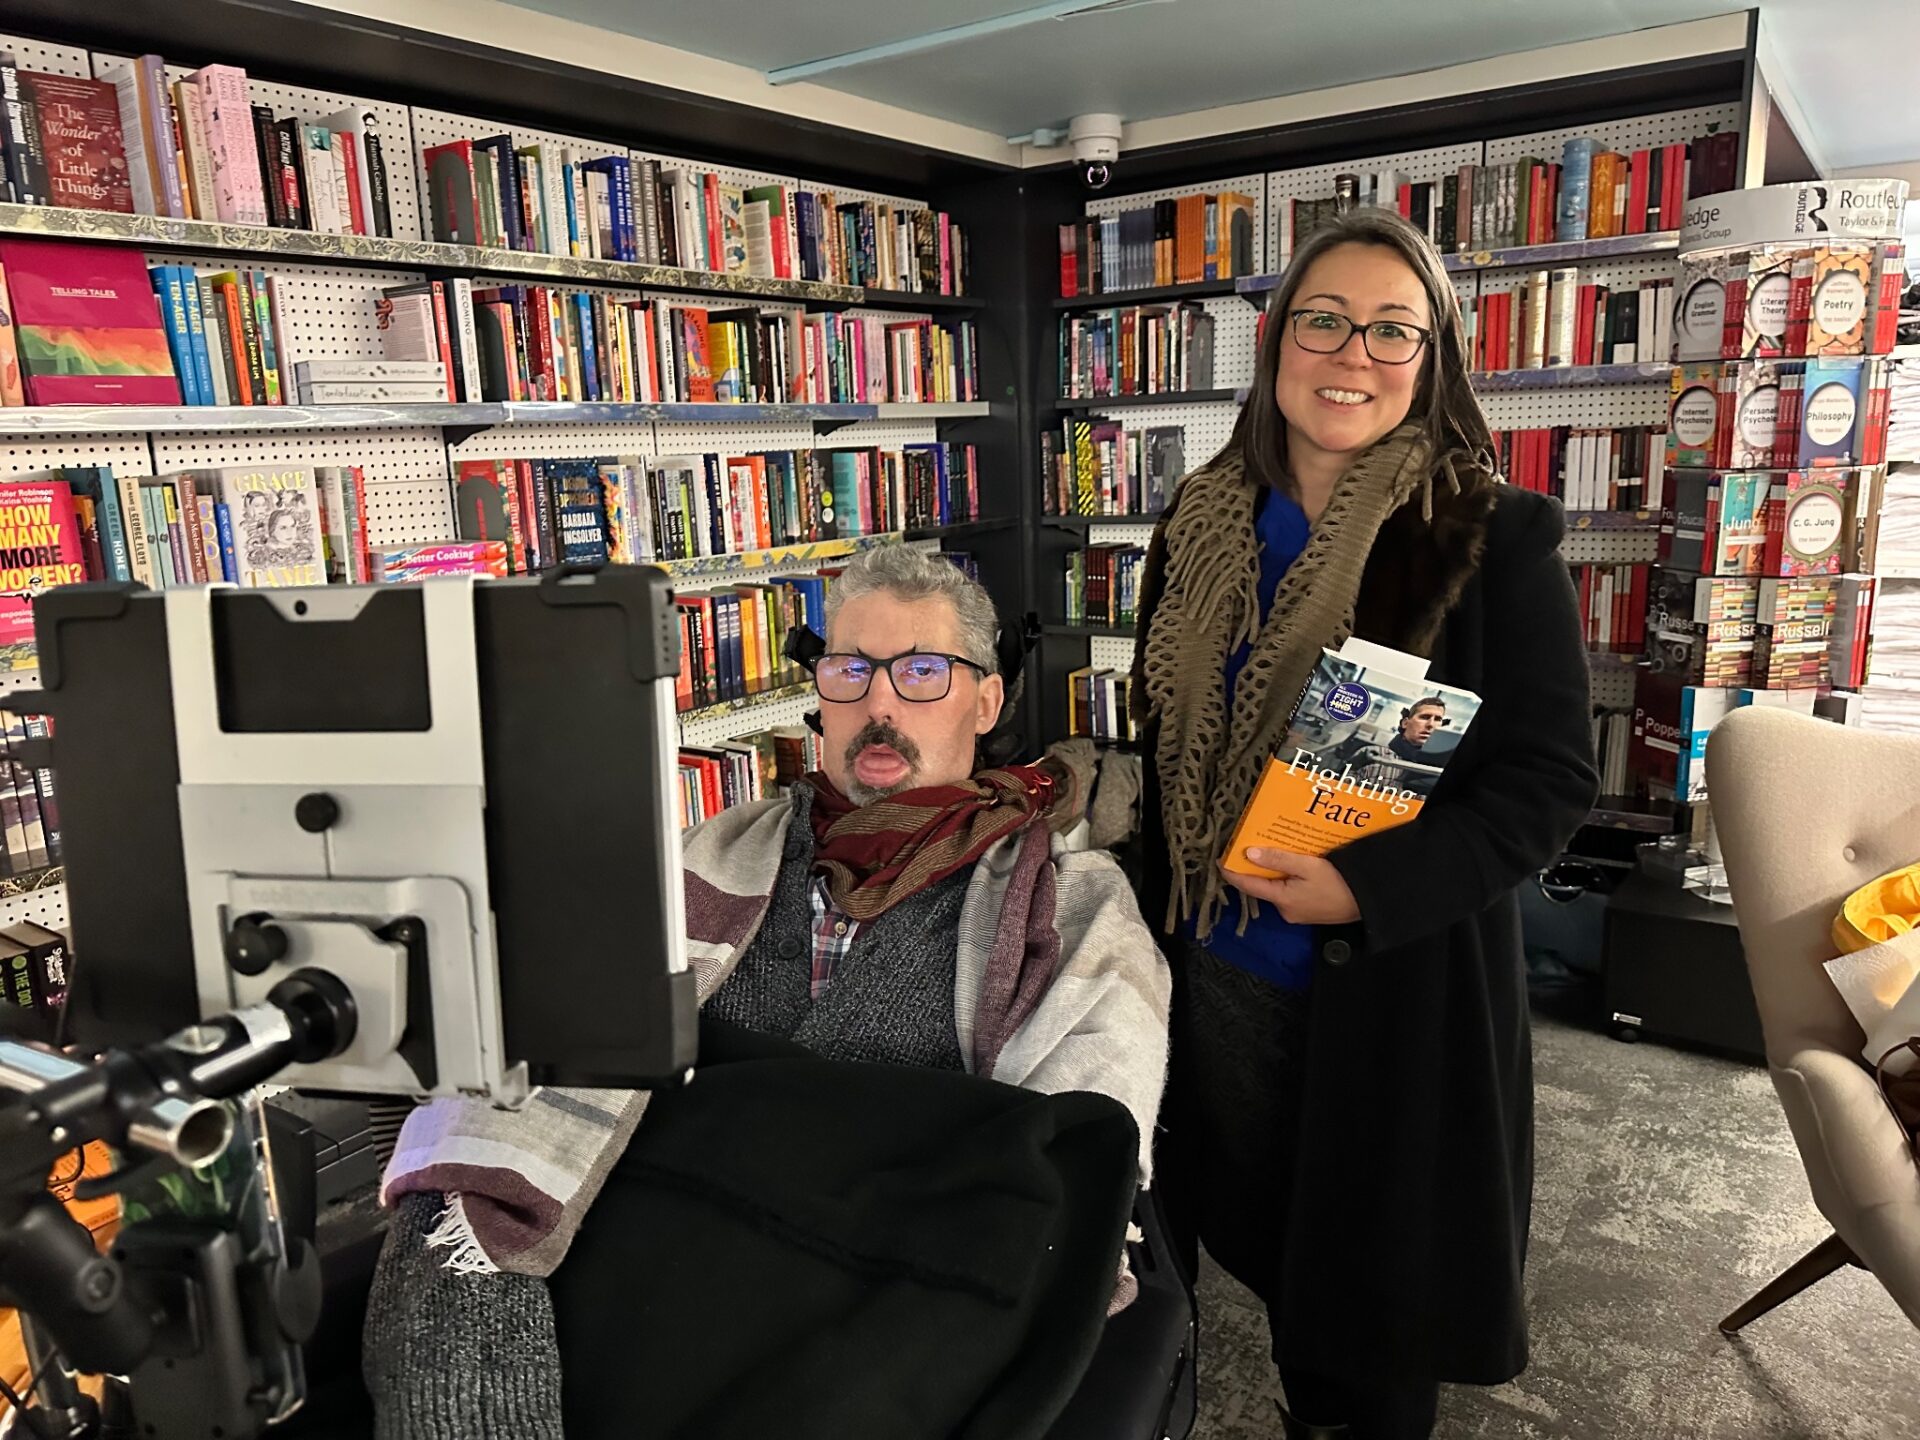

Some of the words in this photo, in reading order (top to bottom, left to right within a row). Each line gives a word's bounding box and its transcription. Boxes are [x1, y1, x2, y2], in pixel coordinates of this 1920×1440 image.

[1, 66, 19, 99] Stalking
[52, 103, 85, 120] The
[7, 102, 27, 144] Claremont
[45, 120, 101, 140] Wonder
[67, 142, 85, 157] of
[280, 131, 291, 151] CATCH
[369, 138, 379, 170] Hannah
[58, 160, 98, 177] Little
[283, 164, 296, 179] KILL
[52, 177, 110, 200] Things
[373, 171, 384, 202] Gadsby
[1840, 216, 1868, 227] Taylor
[1871, 217, 1877, 226] &
[636, 225, 645, 258] BARDUGO
[648, 227, 658, 259] BARDUGO
[1703, 228, 1731, 239] Group
[50, 287, 88, 296] TELLING
[89, 289, 116, 297] TALES
[202, 286, 214, 315] PRICK
[169, 280, 187, 334] TEN-AGER
[185, 281, 202, 335] TEN-AGER
[459, 282, 473, 336] BECOMING
[1694, 301, 1715, 310] English
[1762, 306, 1786, 314] Theory
[1823, 300, 1853, 310] Poetry
[1676, 416, 1713, 424] Psychology
[1806, 411, 1852, 421] Philosophy
[233, 471, 308, 492] GRACE
[505, 467, 514, 494] BEASTS
[536, 466, 546, 506] STEPHEN
[18, 488, 54, 496] Robinson
[184, 480, 193, 509] Finding
[0, 504, 50, 528] HOW
[108, 503, 120, 537] GREEN
[188, 509, 196, 521] the
[509, 503, 518, 525] LITTLE
[538, 507, 548, 531] KING
[562, 512, 596, 528] BARBARA
[1725, 516, 1760, 533] Jung
[1793, 519, 1801, 527] C.
[1814, 518, 1834, 526] Jung
[0, 524, 60, 548] MANY
[131, 514, 142, 540] GEORGE
[137, 543, 147, 565] FLOYD
[191, 523, 200, 550] Mother
[511, 527, 521, 545] LAND
[563, 528, 602, 545] INGSOLVER
[1, 545, 64, 569] MORE
[113, 541, 125, 570] HOME
[437, 550, 474, 560] Cooking
[245, 563, 317, 588] TAME
[1777, 620, 1830, 639] Russell
[1334, 692, 1363, 707] FIGHT
[30, 722, 43, 737] THE
[1646, 717, 1680, 739] Poppe
[1284, 747, 1417, 815] Fighting
[1305, 788, 1371, 828] Fate
[14, 970, 30, 990] THE
